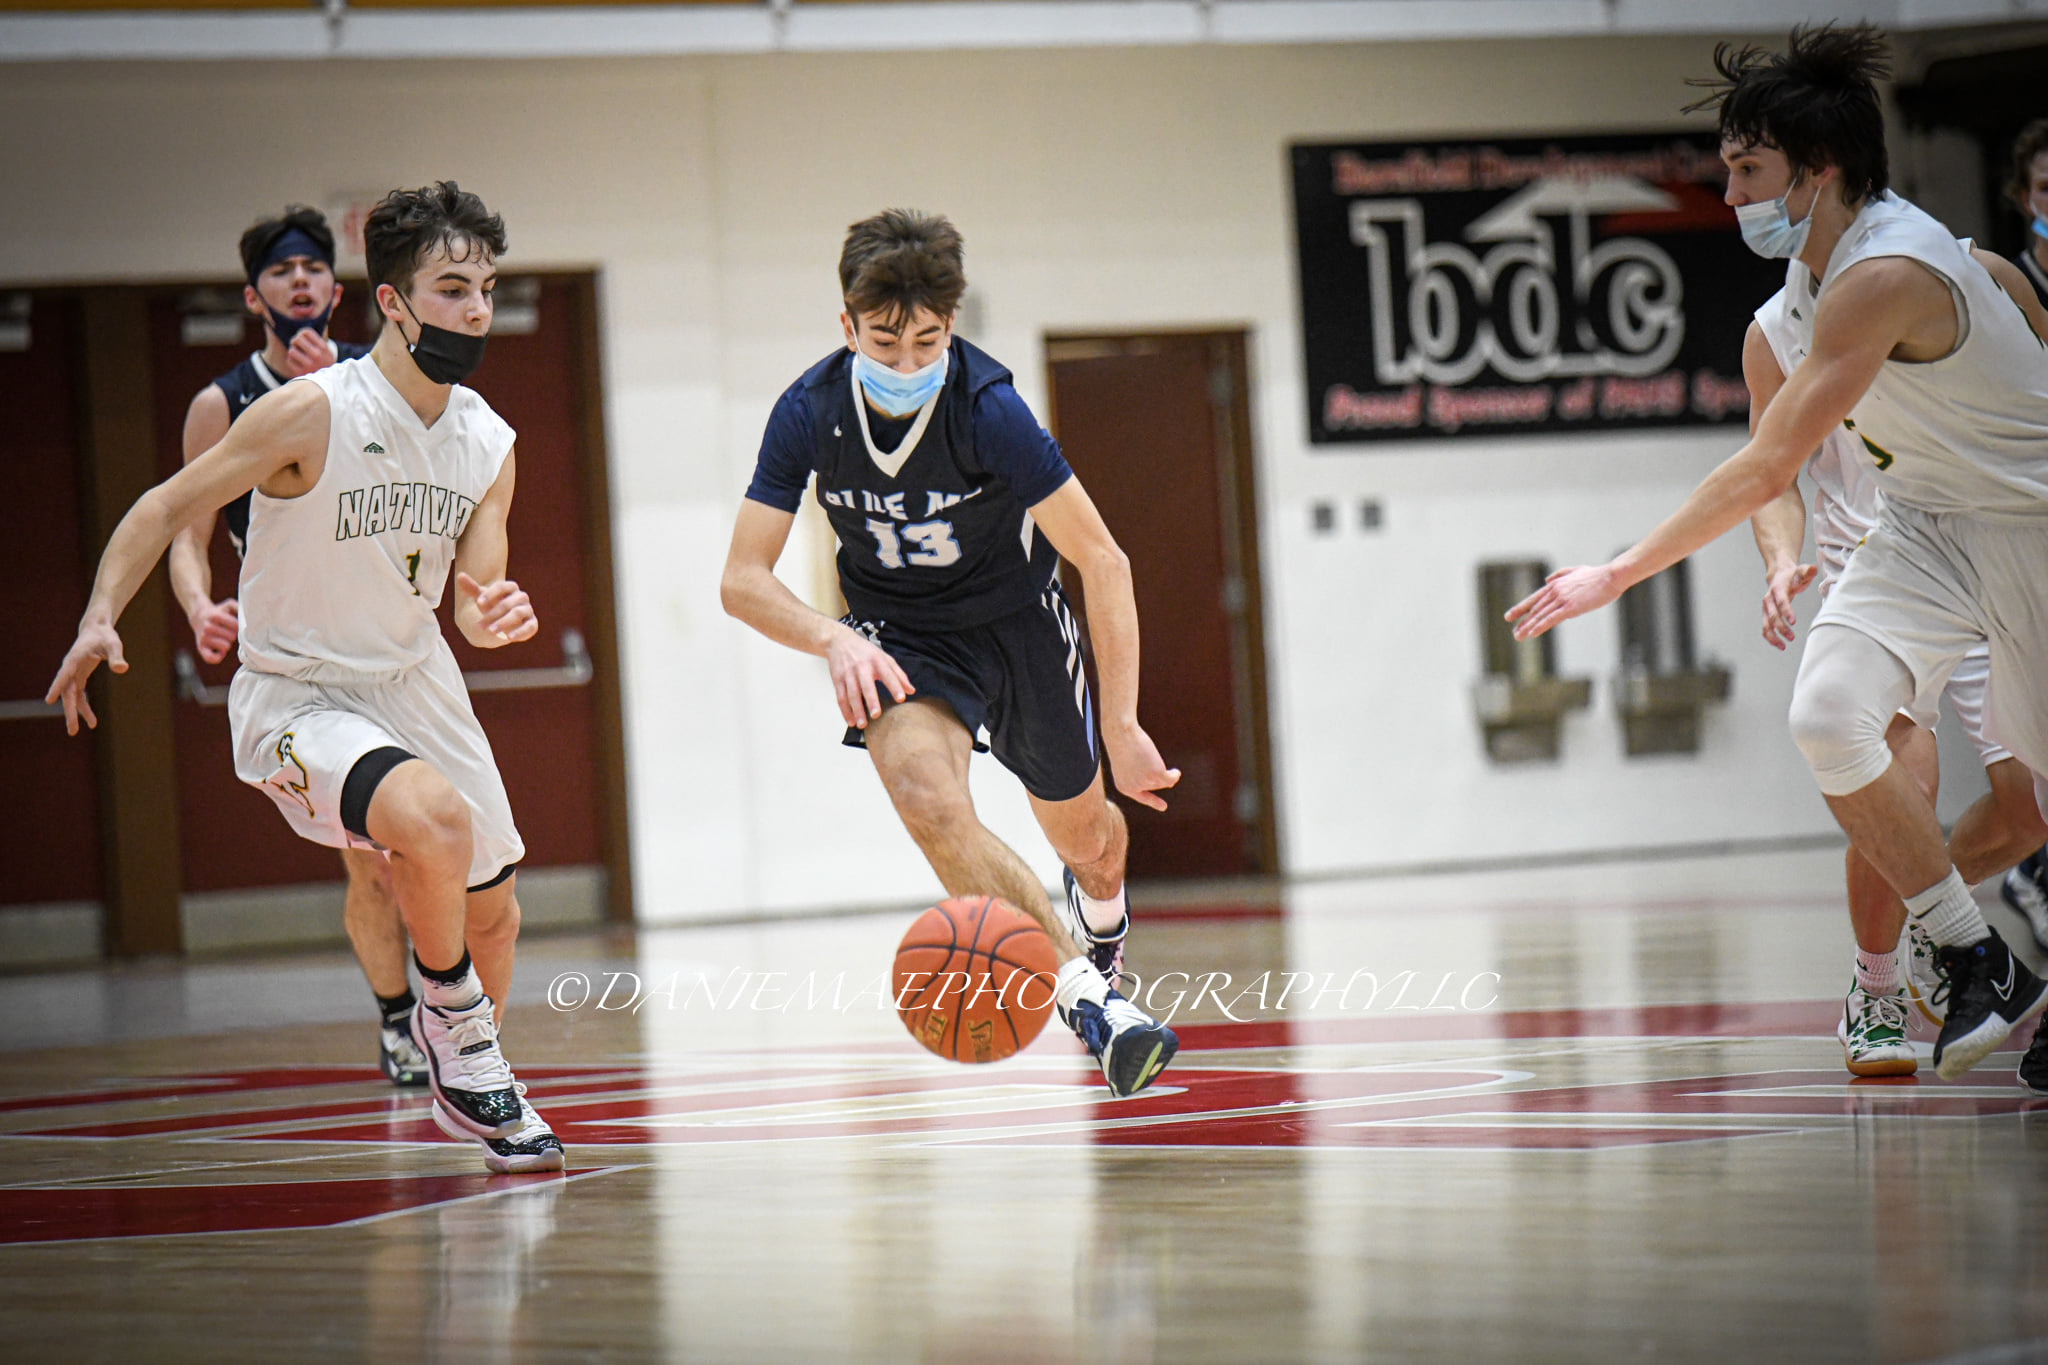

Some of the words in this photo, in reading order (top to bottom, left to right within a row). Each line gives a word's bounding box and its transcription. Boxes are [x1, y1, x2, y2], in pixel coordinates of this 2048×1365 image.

[1349, 200, 1685, 385] bdc
[866, 518, 963, 569] 13
[406, 549, 421, 596] 1
